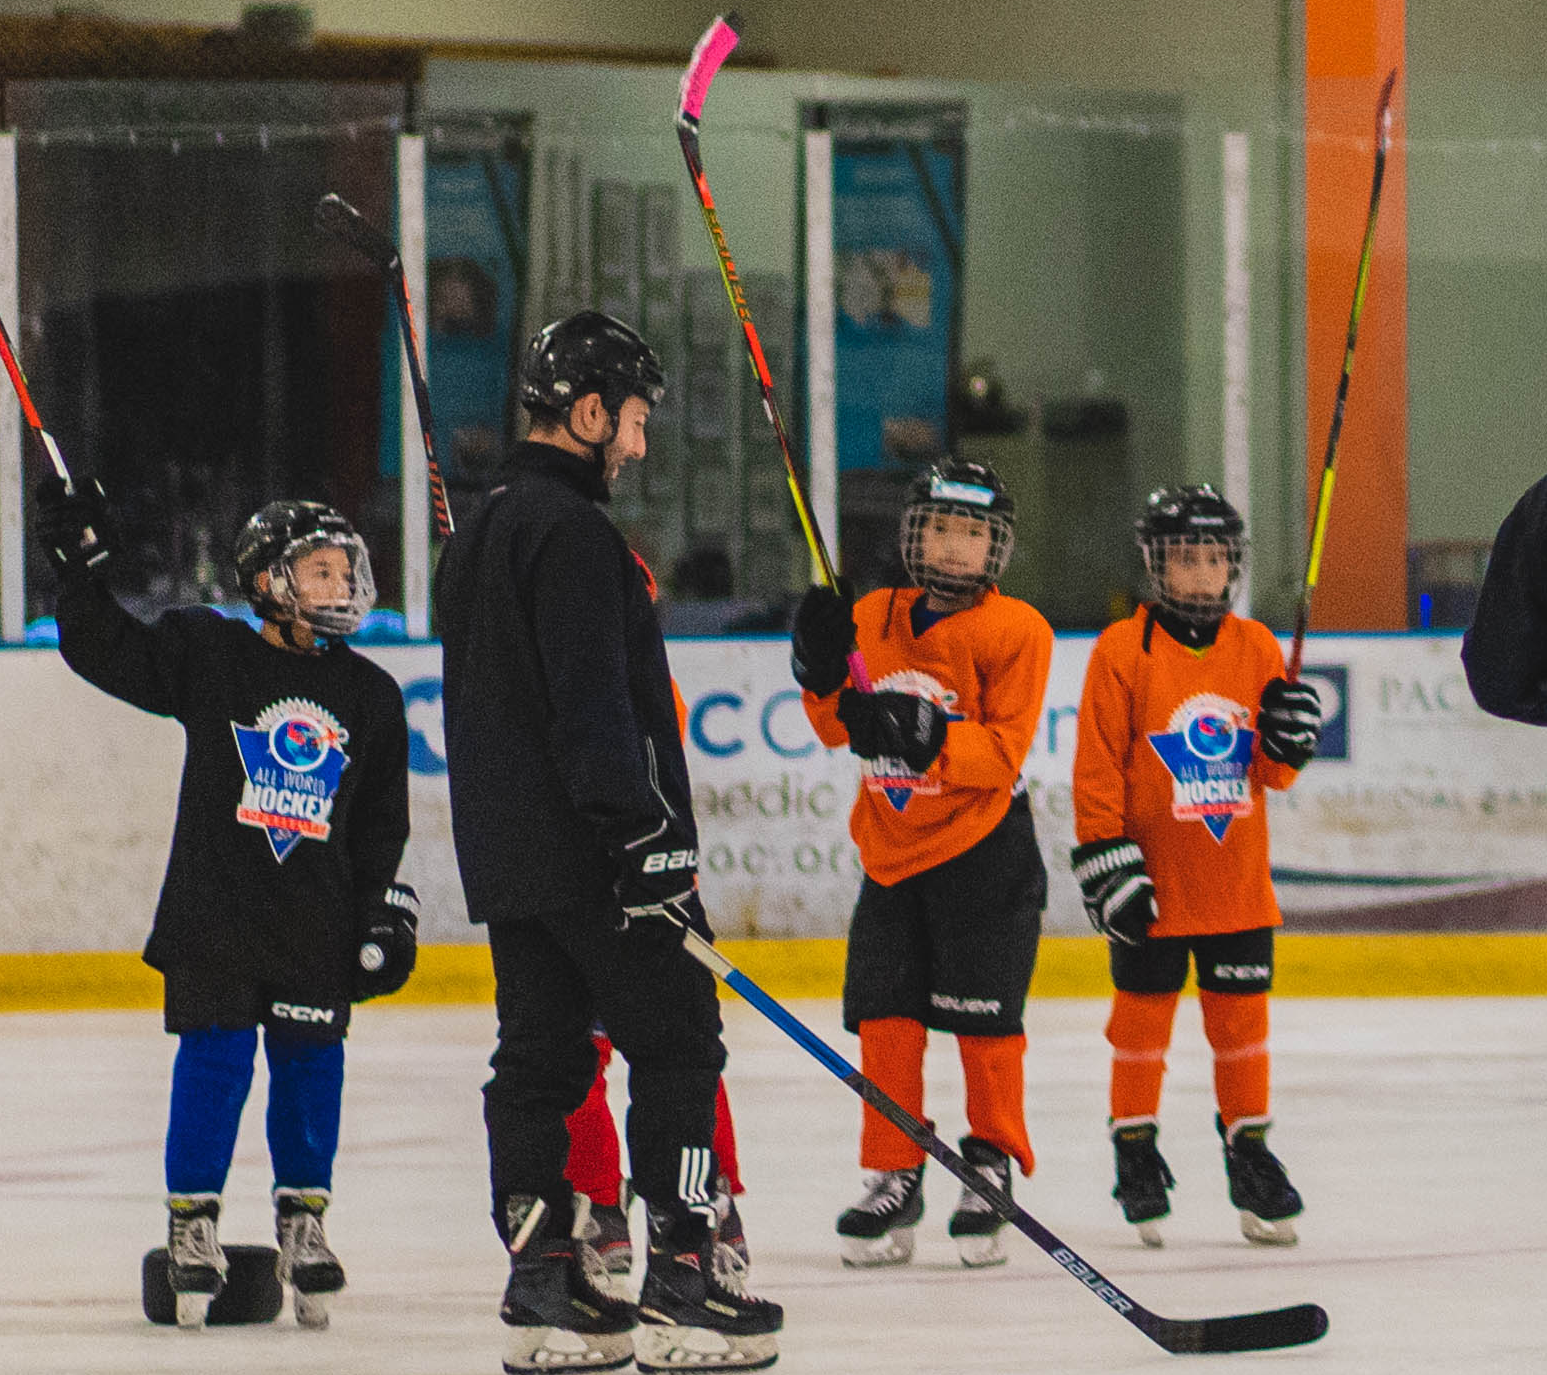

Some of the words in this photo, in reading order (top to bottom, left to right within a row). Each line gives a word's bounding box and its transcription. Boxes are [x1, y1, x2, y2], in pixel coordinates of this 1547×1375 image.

[241, 779, 334, 825] HOCKEY
[642, 849, 700, 873] BAU
[271, 1001, 336, 1025] CCM
[1052, 1247, 1134, 1315] BAUER
